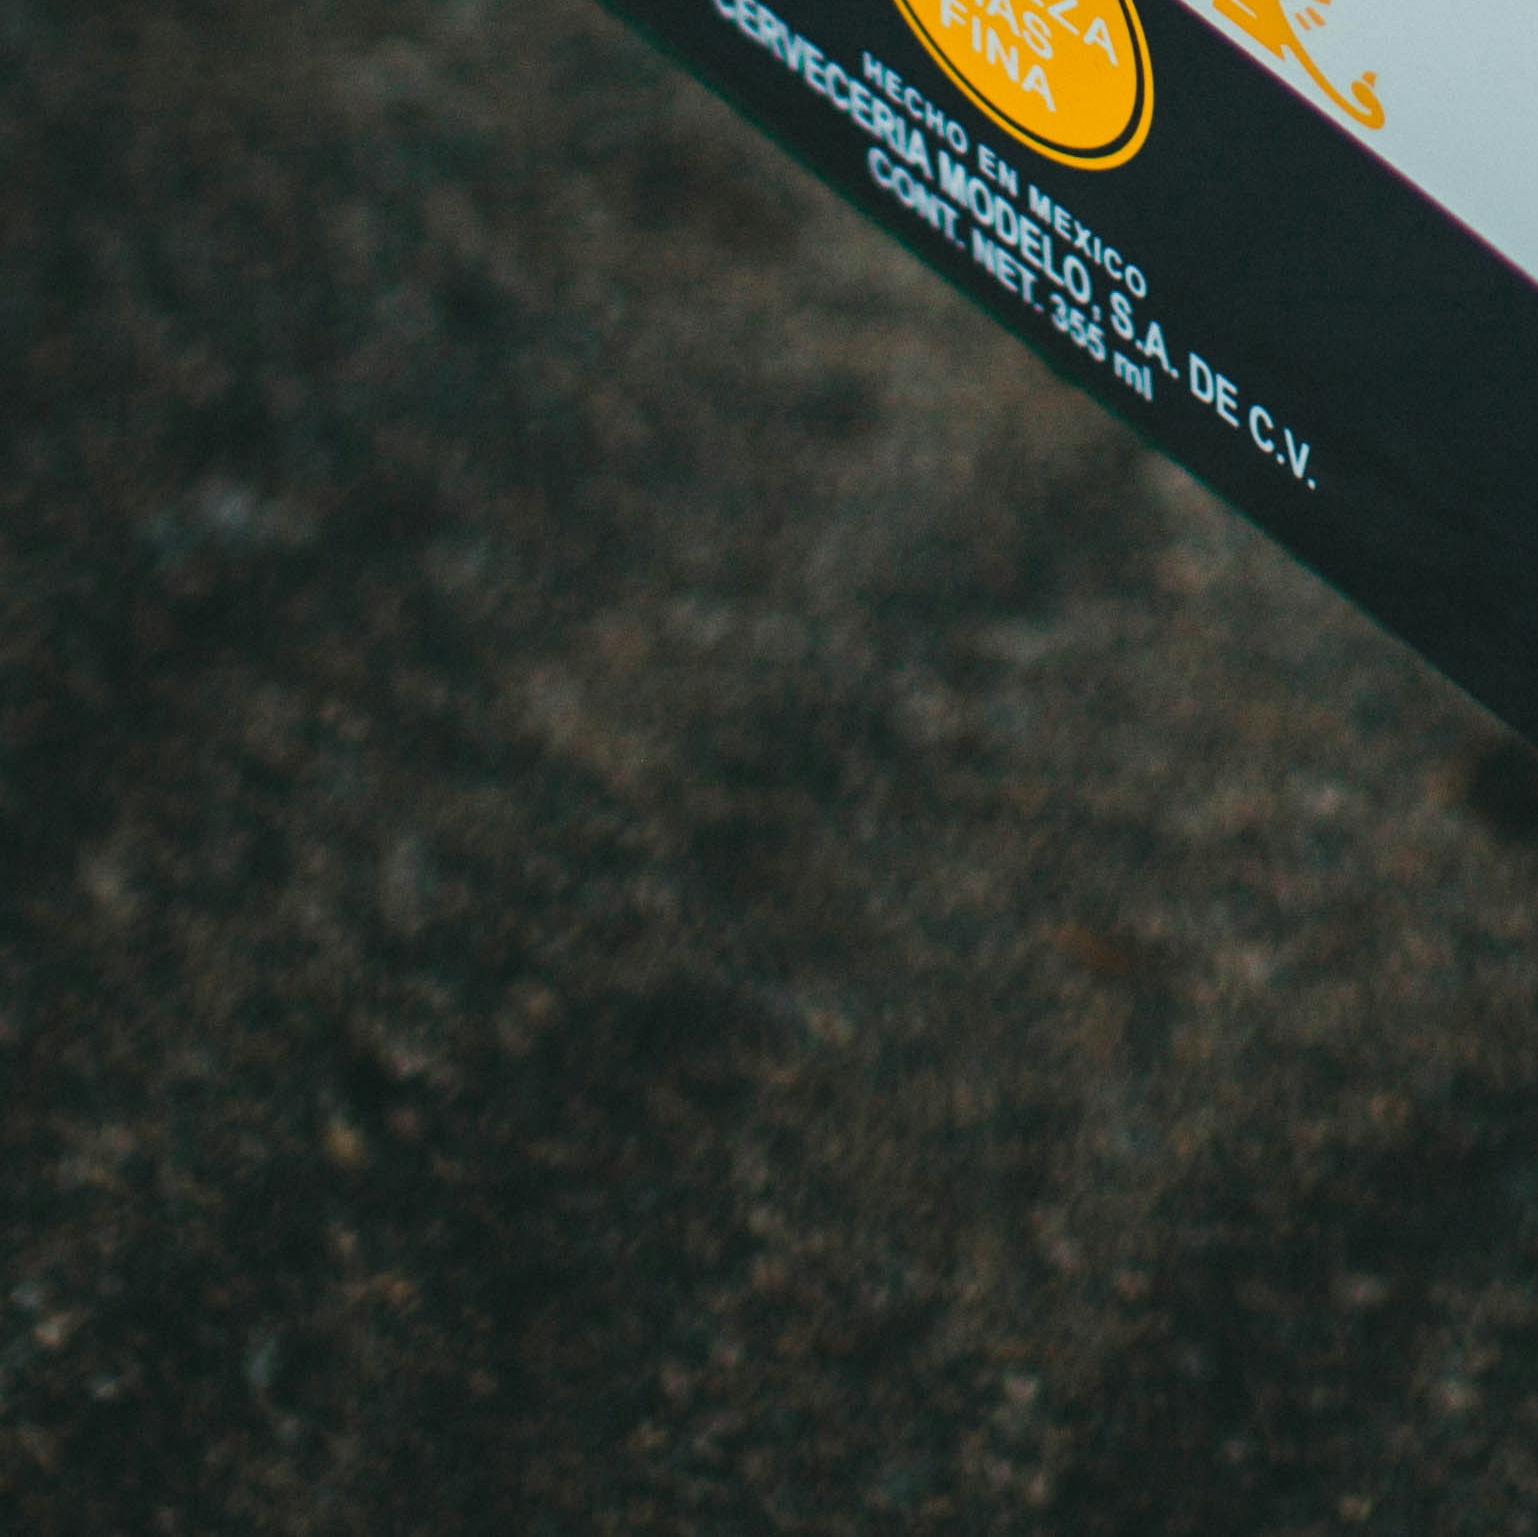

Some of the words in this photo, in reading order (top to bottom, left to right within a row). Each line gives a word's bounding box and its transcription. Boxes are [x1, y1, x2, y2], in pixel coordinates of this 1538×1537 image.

[861, 50, 968, 155] HECHO
[977, 143, 1019, 198] EN
[1028, 184, 1148, 299] MEXICO
[867, 146, 966, 250] CONT.
[972, 228, 1044, 313] NET.
[1050, 292, 1107, 362] 355
[1112, 351, 1153, 403] ml
[1110, 290, 1179, 380] S.A.
[1188, 350, 1240, 429] DE
[1248, 404, 1316, 491] C.V.
